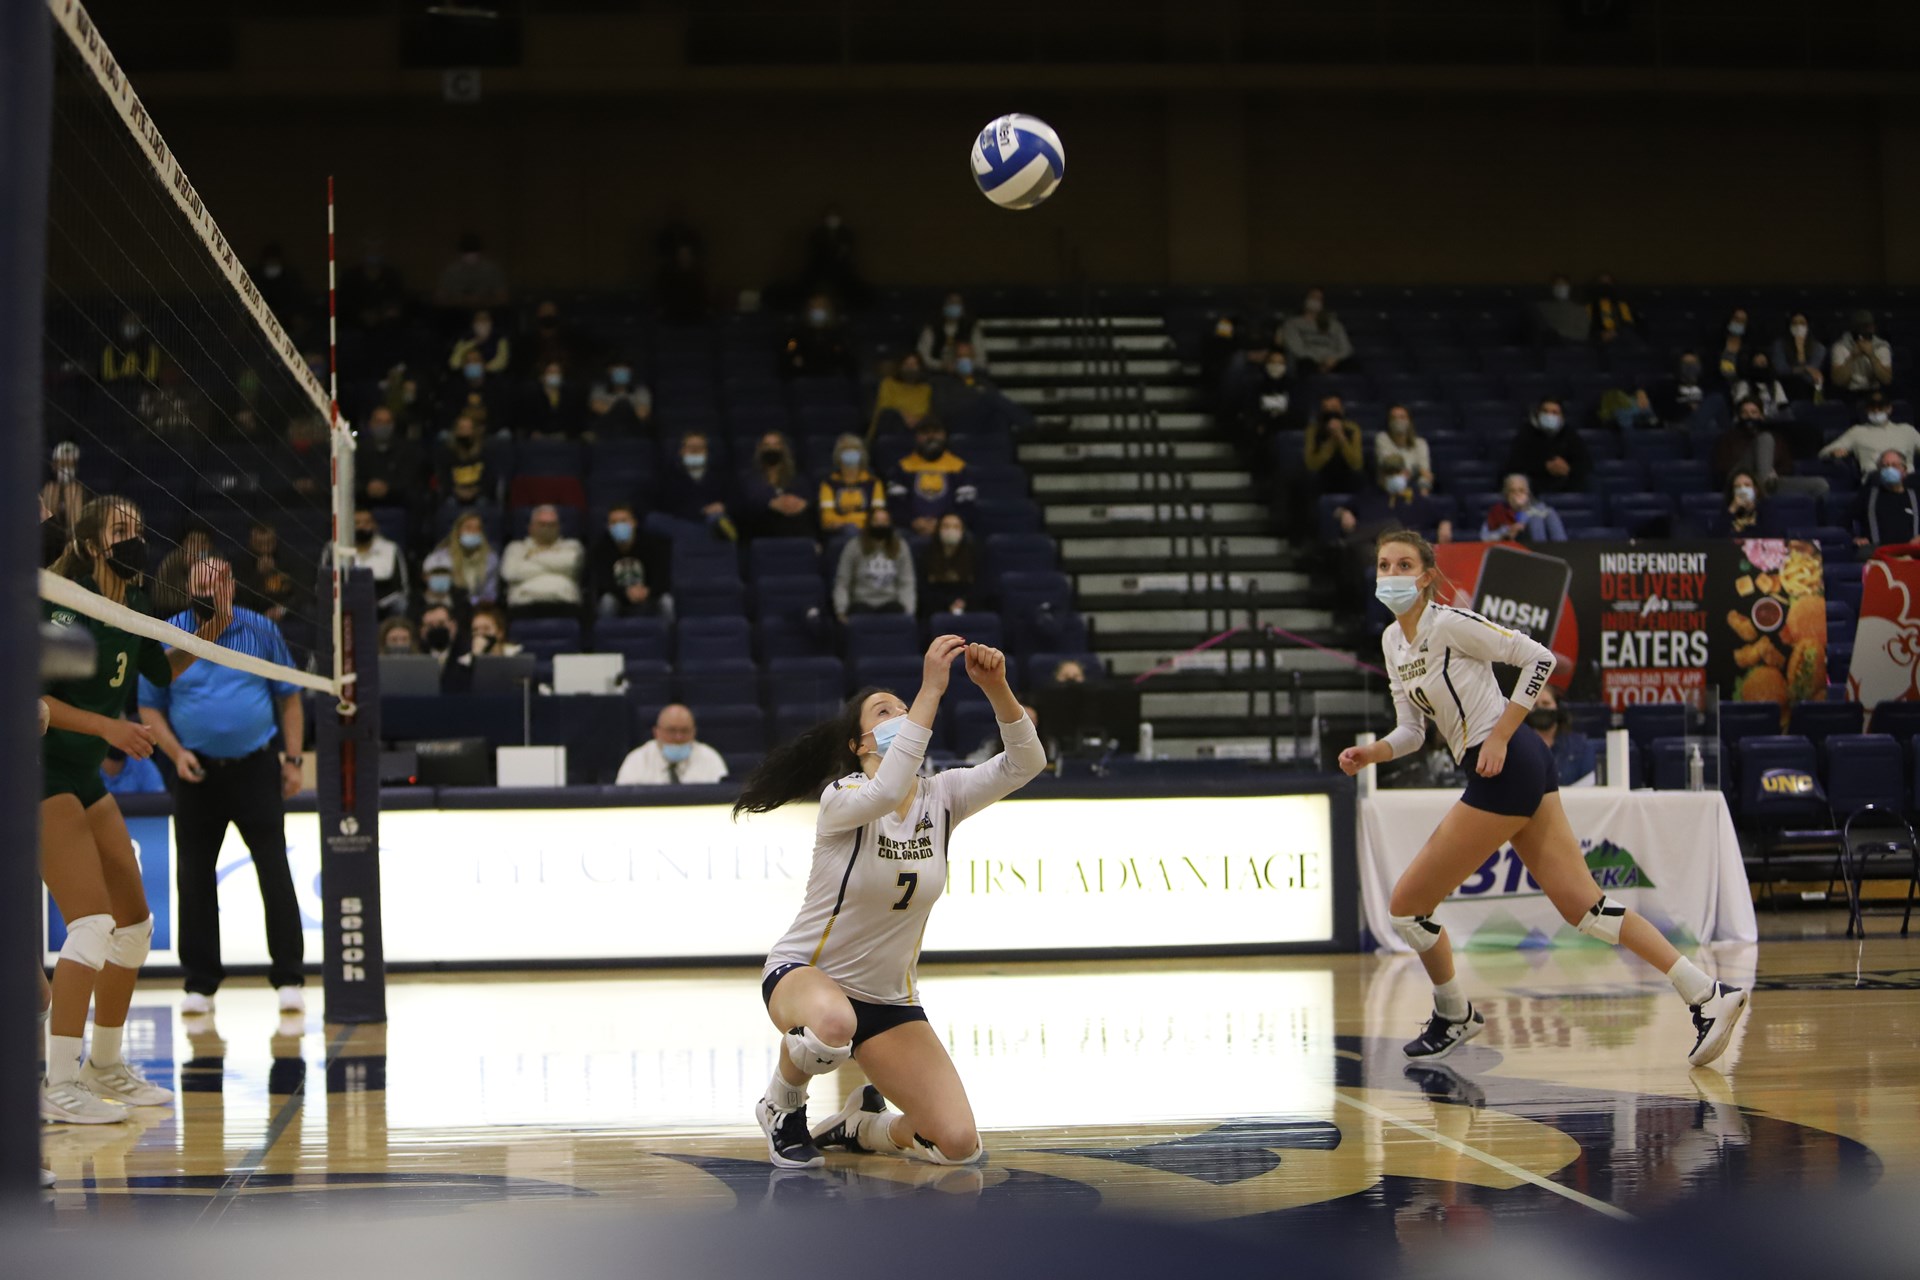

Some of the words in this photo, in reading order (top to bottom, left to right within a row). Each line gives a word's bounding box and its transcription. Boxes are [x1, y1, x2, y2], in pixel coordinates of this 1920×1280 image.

[1600, 553, 1707, 573] INDEPENDENT
[1601, 573, 1706, 600] DELIVERY
[1481, 595, 1549, 630] NOSH
[1601, 611, 1706, 631] INDEPENDENT
[1601, 630, 1708, 667] EATERS
[109, 651, 127, 687] 3
[1682, 671, 1701, 685] APP
[1761, 774, 1813, 793] UNC
[878, 848, 933, 860] COLORADO
[891, 871, 918, 911] 7
[340, 897, 365, 982] senoh
